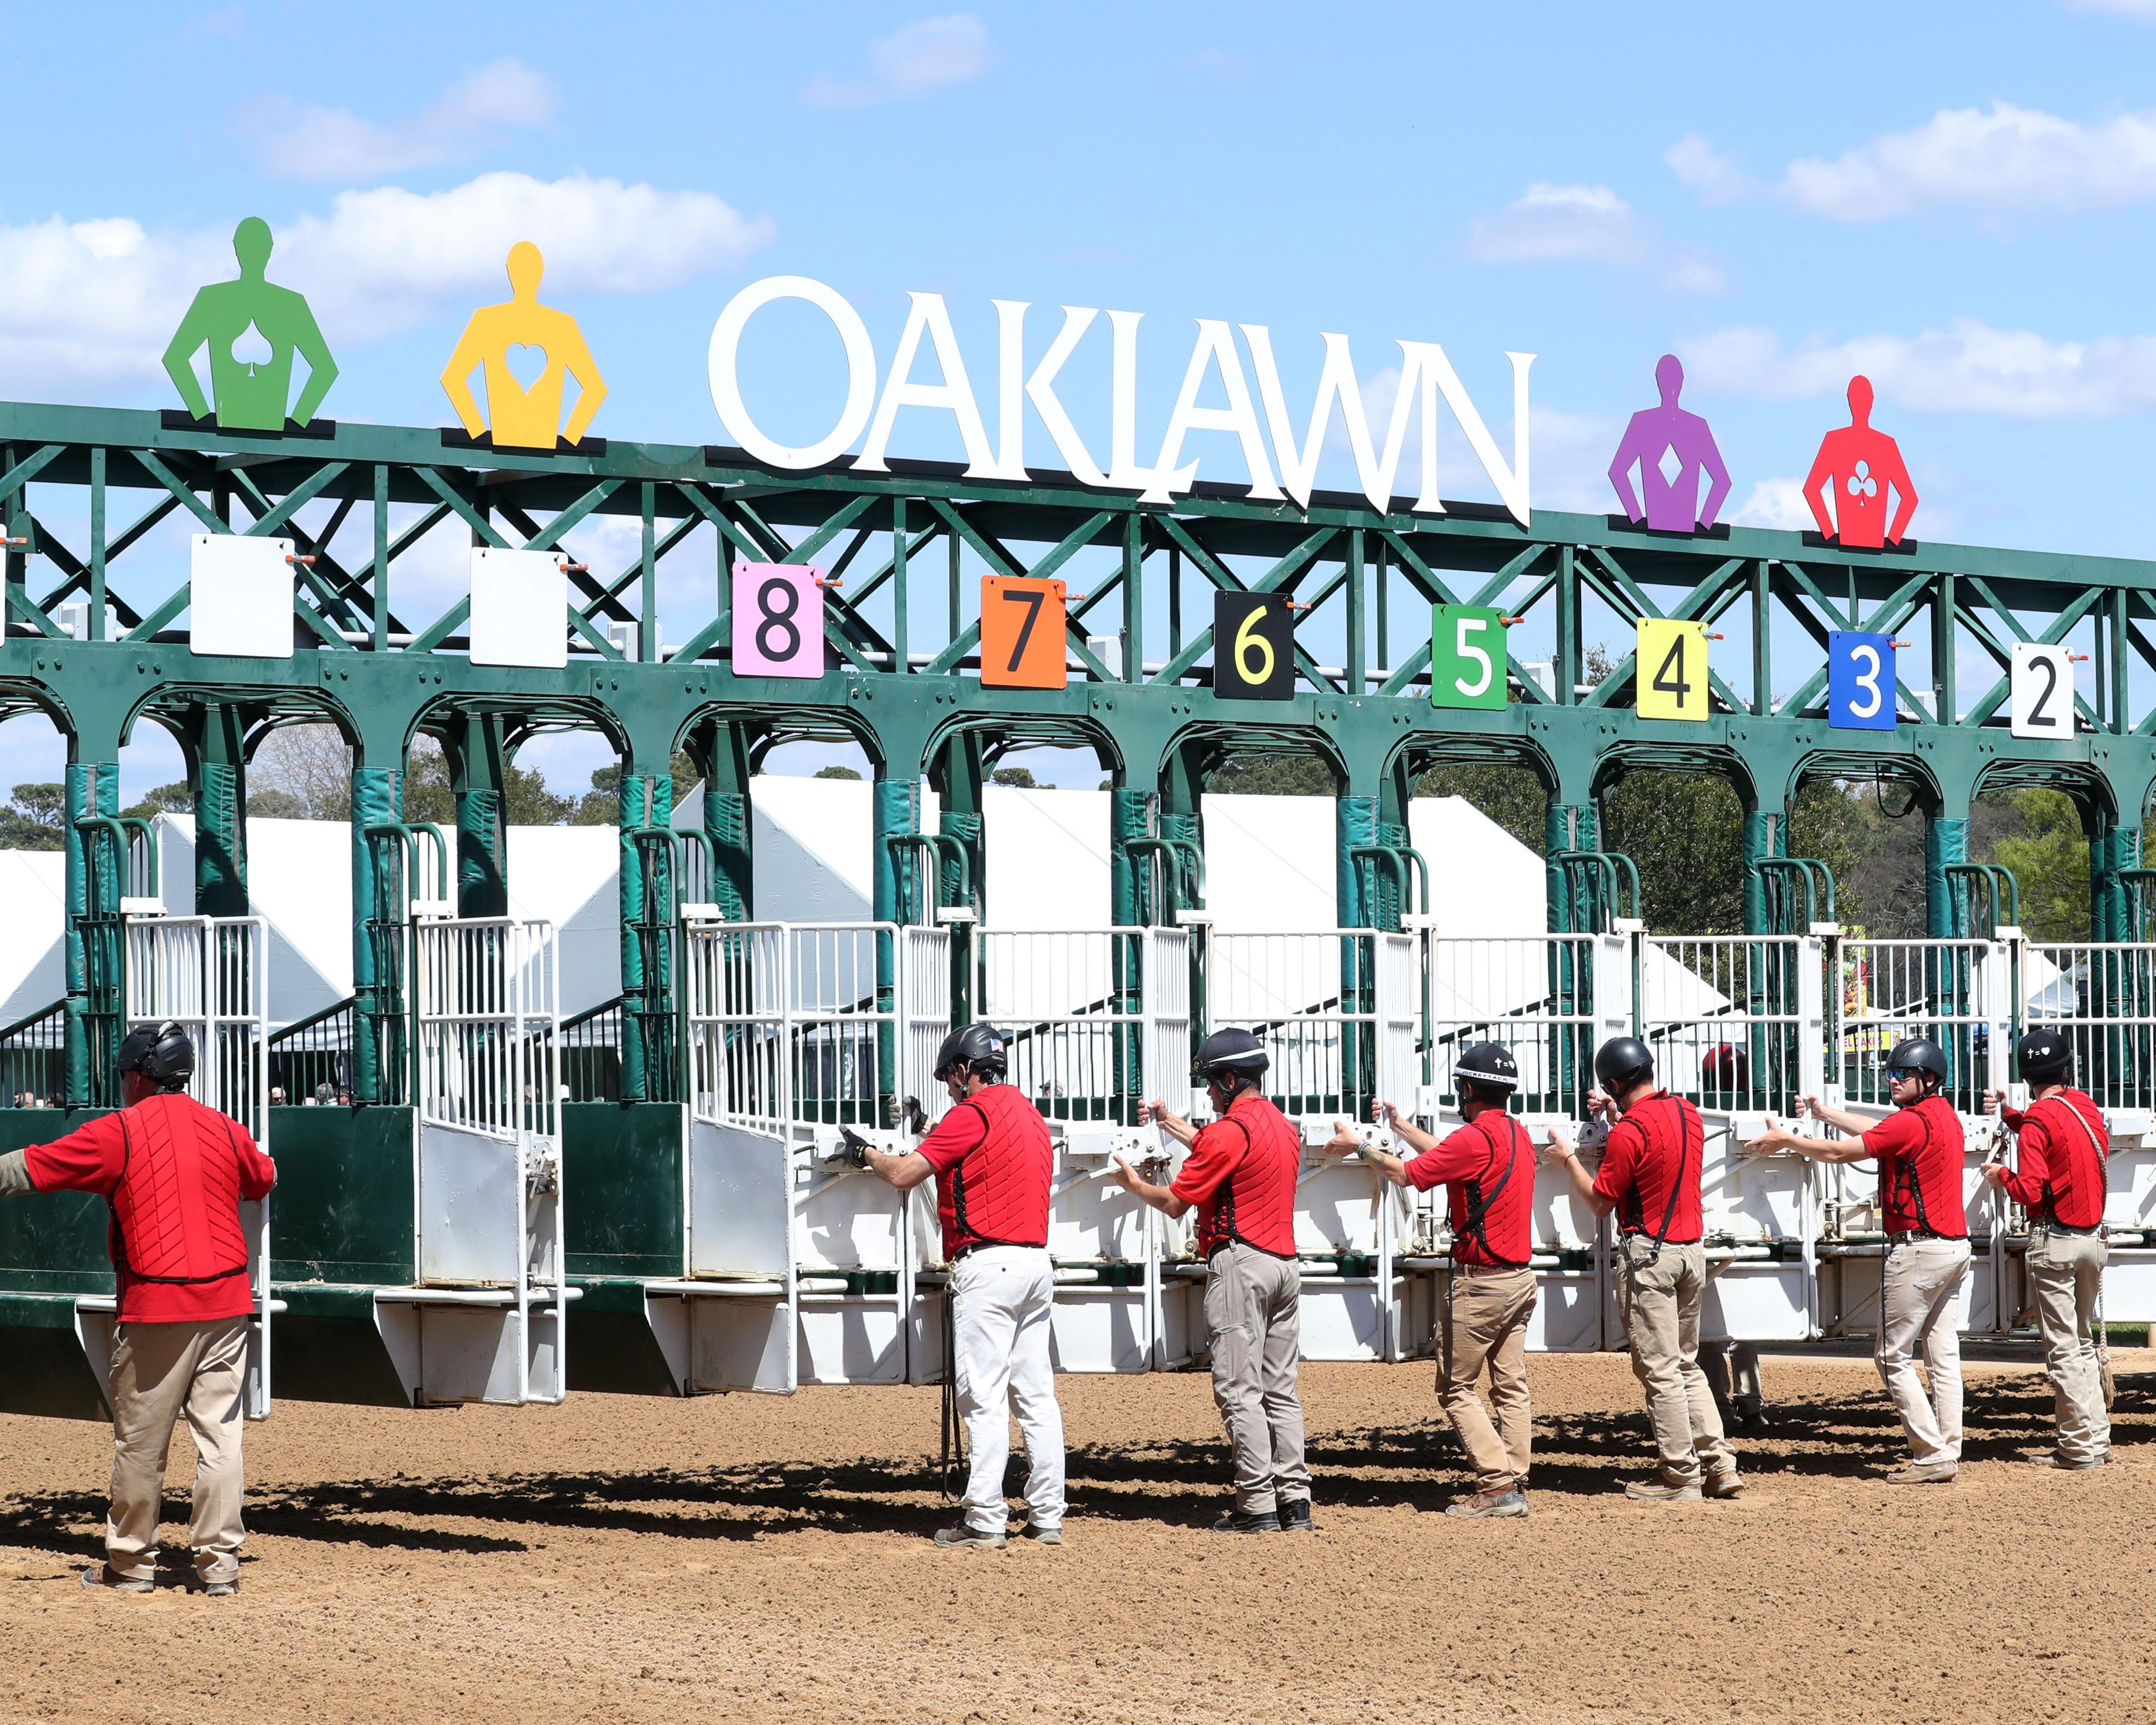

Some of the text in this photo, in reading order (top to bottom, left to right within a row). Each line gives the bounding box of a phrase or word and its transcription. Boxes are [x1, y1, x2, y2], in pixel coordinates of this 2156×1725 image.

[708, 275, 1537, 528] OAKLAWN
[756, 578, 800, 662] 8
[1003, 590, 1044, 671] 7
[1234, 605, 1274, 685] 6
[1454, 618, 1493, 697] 5
[1653, 634, 1691, 709] 4
[1848, 644, 1882, 718] 3
[2028, 656, 2057, 727] 2
